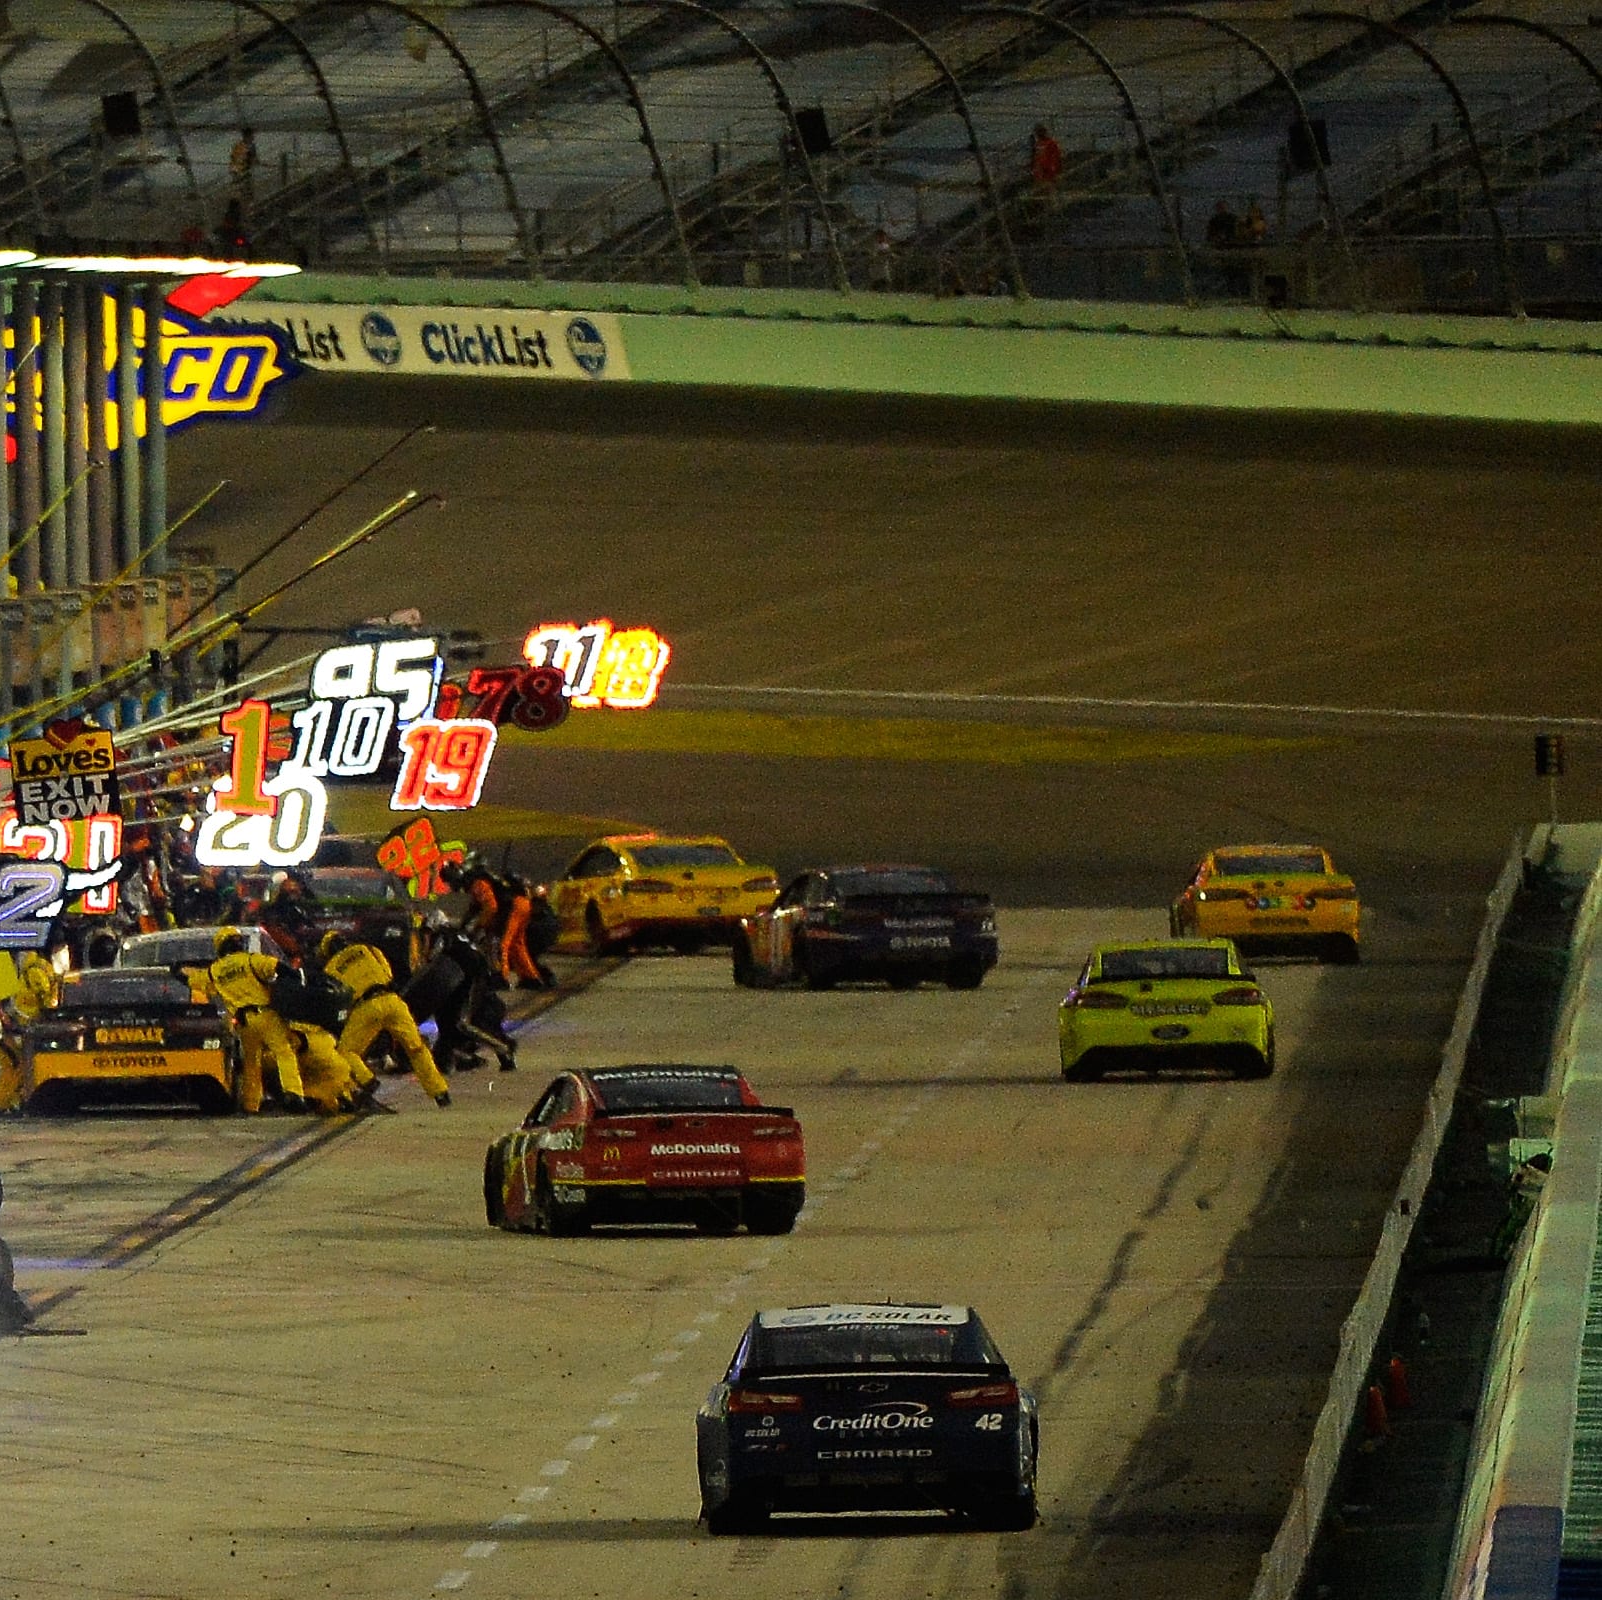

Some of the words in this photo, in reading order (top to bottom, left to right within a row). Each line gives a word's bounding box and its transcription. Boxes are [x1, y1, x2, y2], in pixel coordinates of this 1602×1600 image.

[420, 320, 553, 368] ClickList
[282, 696, 395, 777] 10
[390, 718, 499, 811] 19
[21, 774, 110, 802] EXIT
[24, 796, 111, 824] NOW
[651, 1142, 741, 1156] McDonald's
[865, 1310, 953, 1325] SOLAR
[813, 1410, 933, 1430] CreditOne
[975, 1413, 1003, 1431] 42
[817, 1448, 932, 1461] CAMARO
